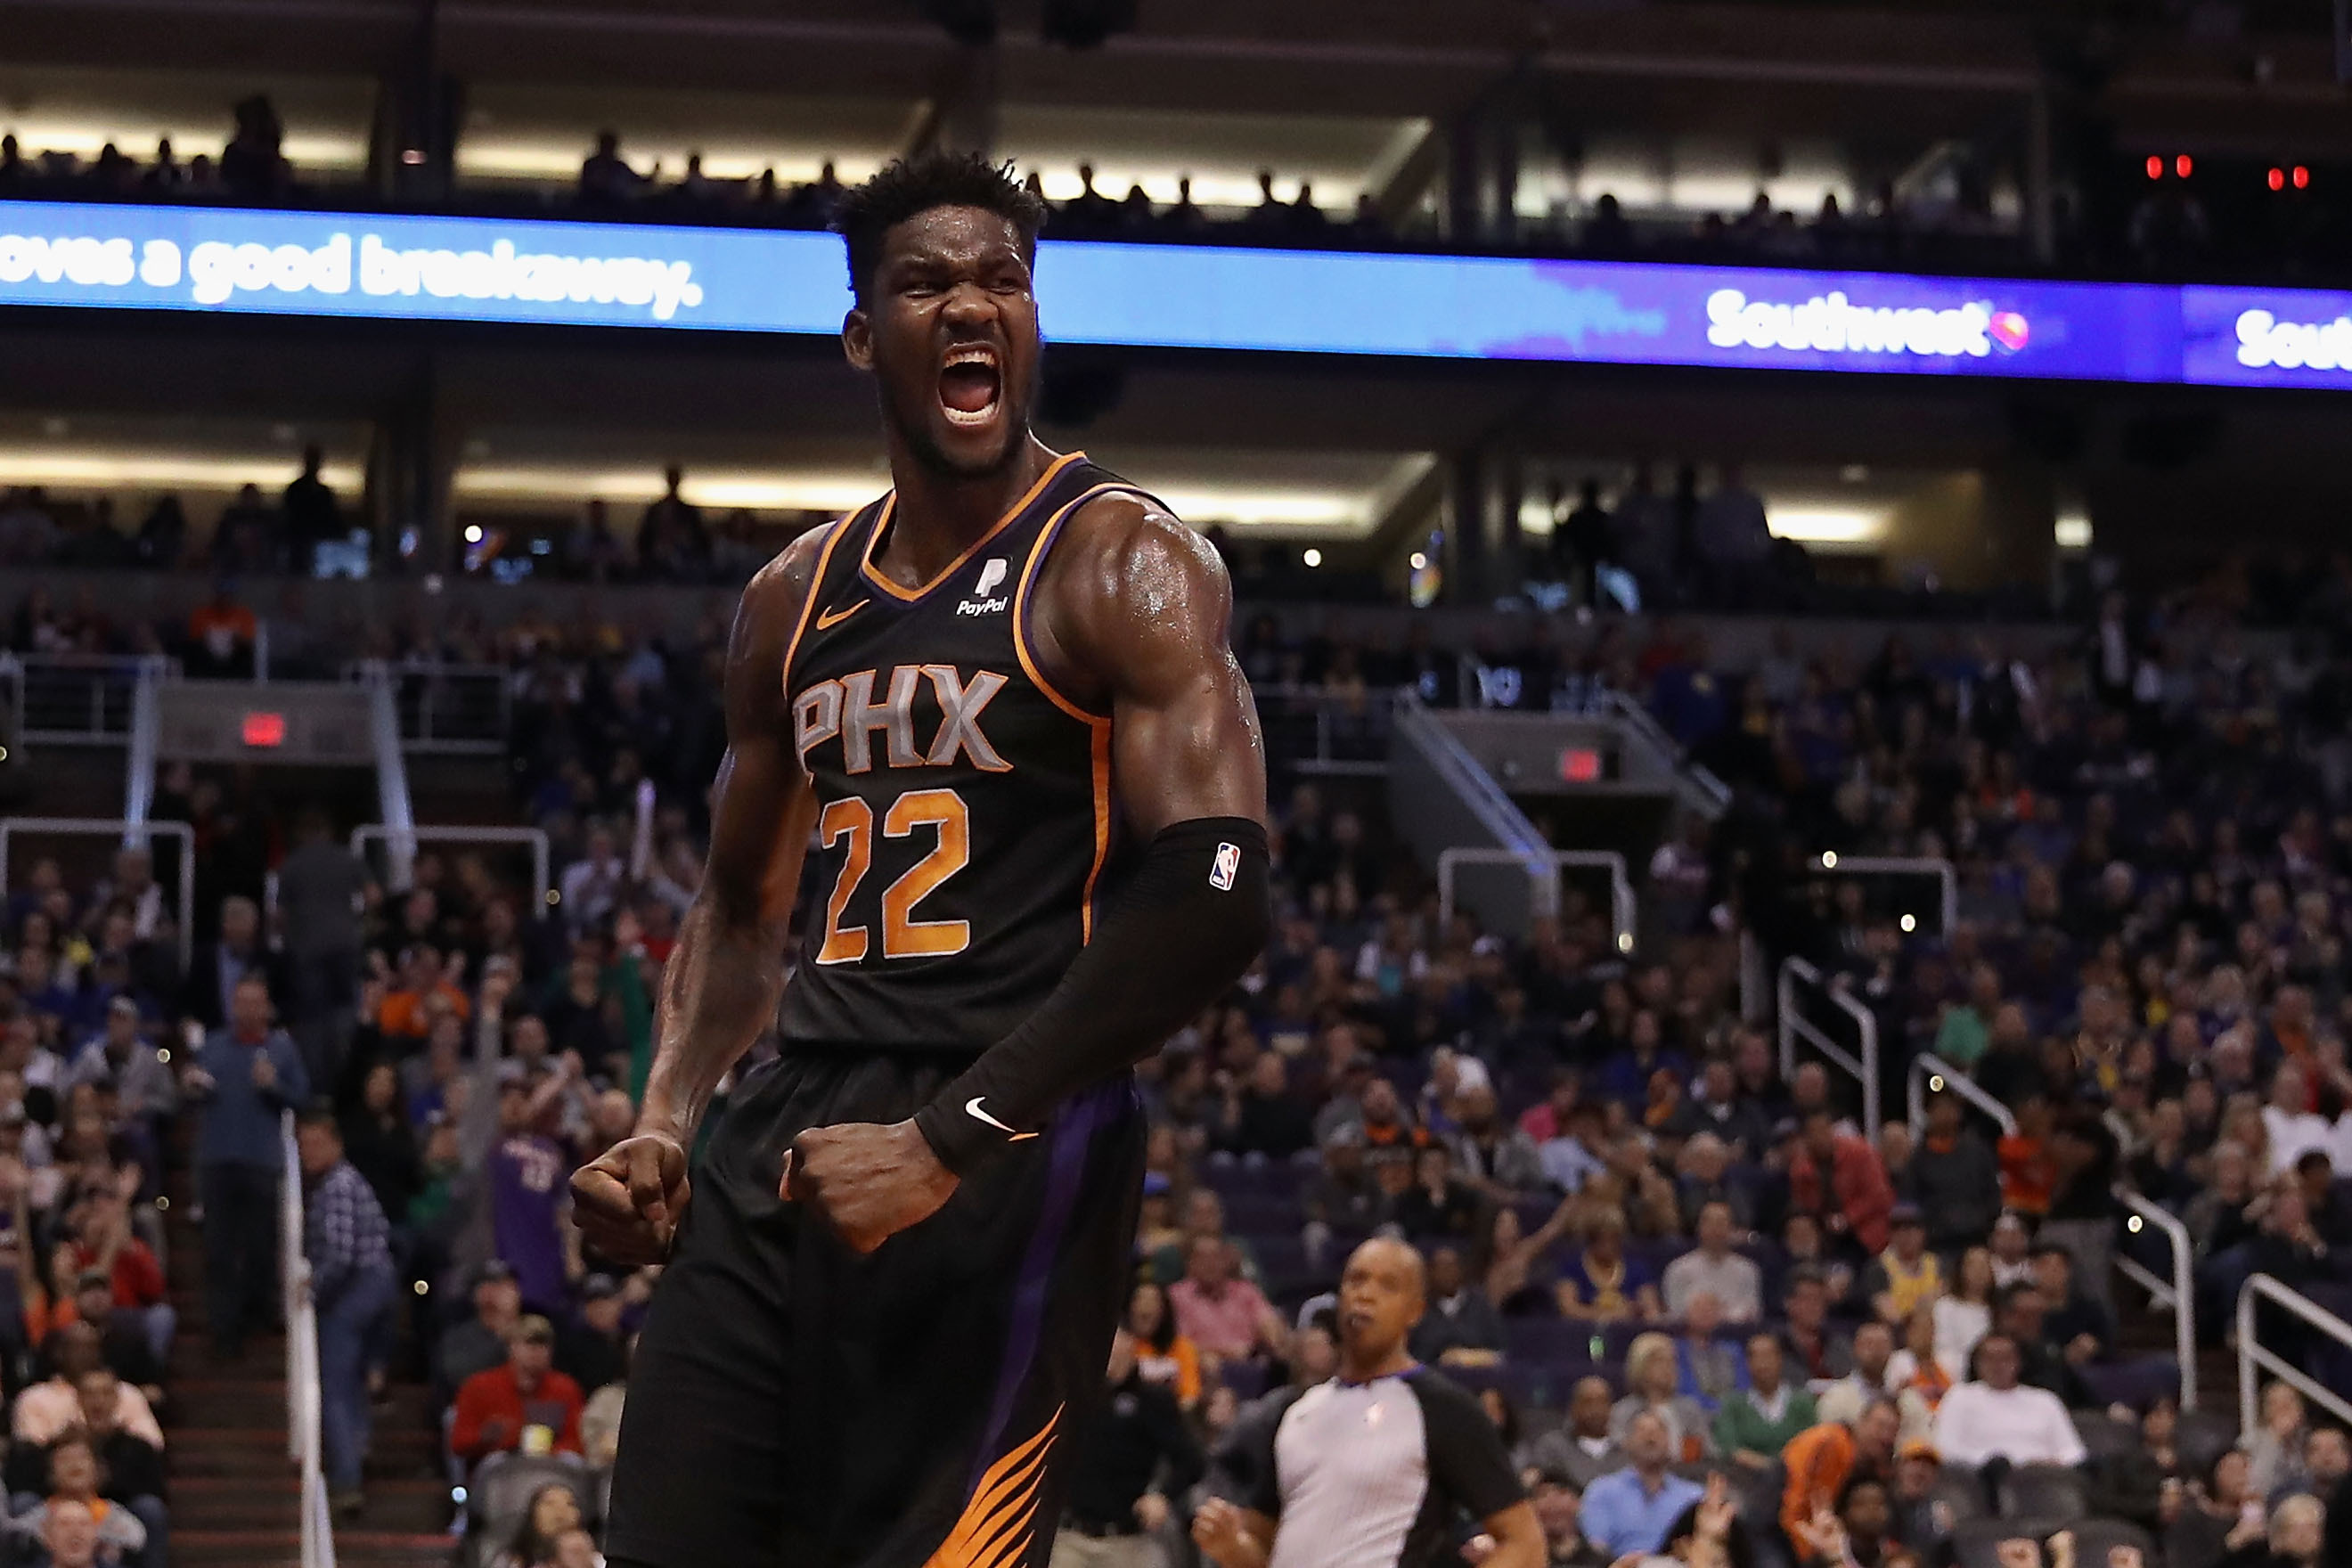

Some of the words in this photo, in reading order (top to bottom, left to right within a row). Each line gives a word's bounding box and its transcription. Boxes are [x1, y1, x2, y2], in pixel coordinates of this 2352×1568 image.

[140, 239, 181, 287] a
[189, 233, 351, 304] good
[360, 233, 703, 320] breakaway.
[1706, 289, 1991, 356] Southwest
[956, 596, 1008, 617] PayPal
[793, 665, 1014, 785] PHX
[816, 788, 969, 965] 22
